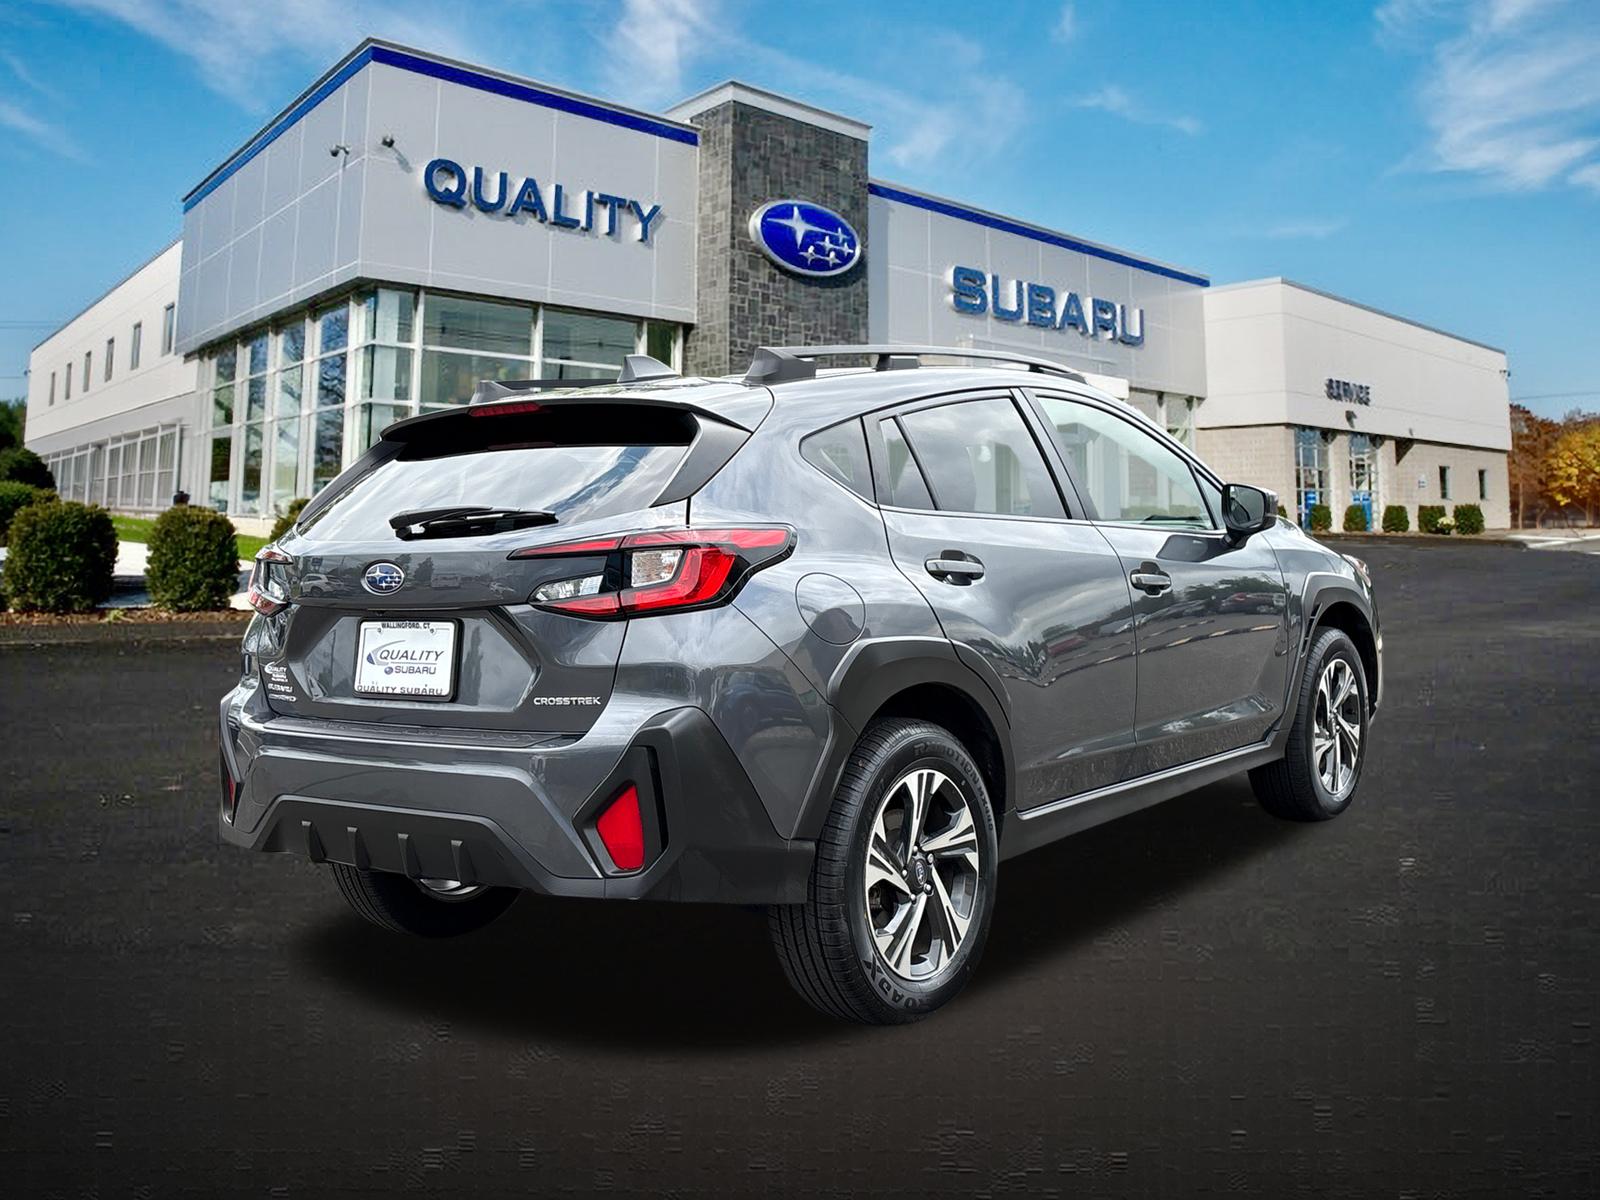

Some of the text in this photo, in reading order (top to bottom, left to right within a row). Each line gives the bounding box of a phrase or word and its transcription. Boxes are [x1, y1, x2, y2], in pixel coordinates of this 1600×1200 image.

[424, 158, 661, 243] QUALITY
[952, 265, 1144, 346] SUBARU
[1324, 377, 1370, 407] SERVICE
[379, 649, 444, 661] QUALITY
[394, 666, 436, 675] SUBARU
[357, 684, 442, 696] QUALITY SUBARU
[533, 696, 601, 705] CROSSTREK
[862, 953, 931, 1009] OADX
